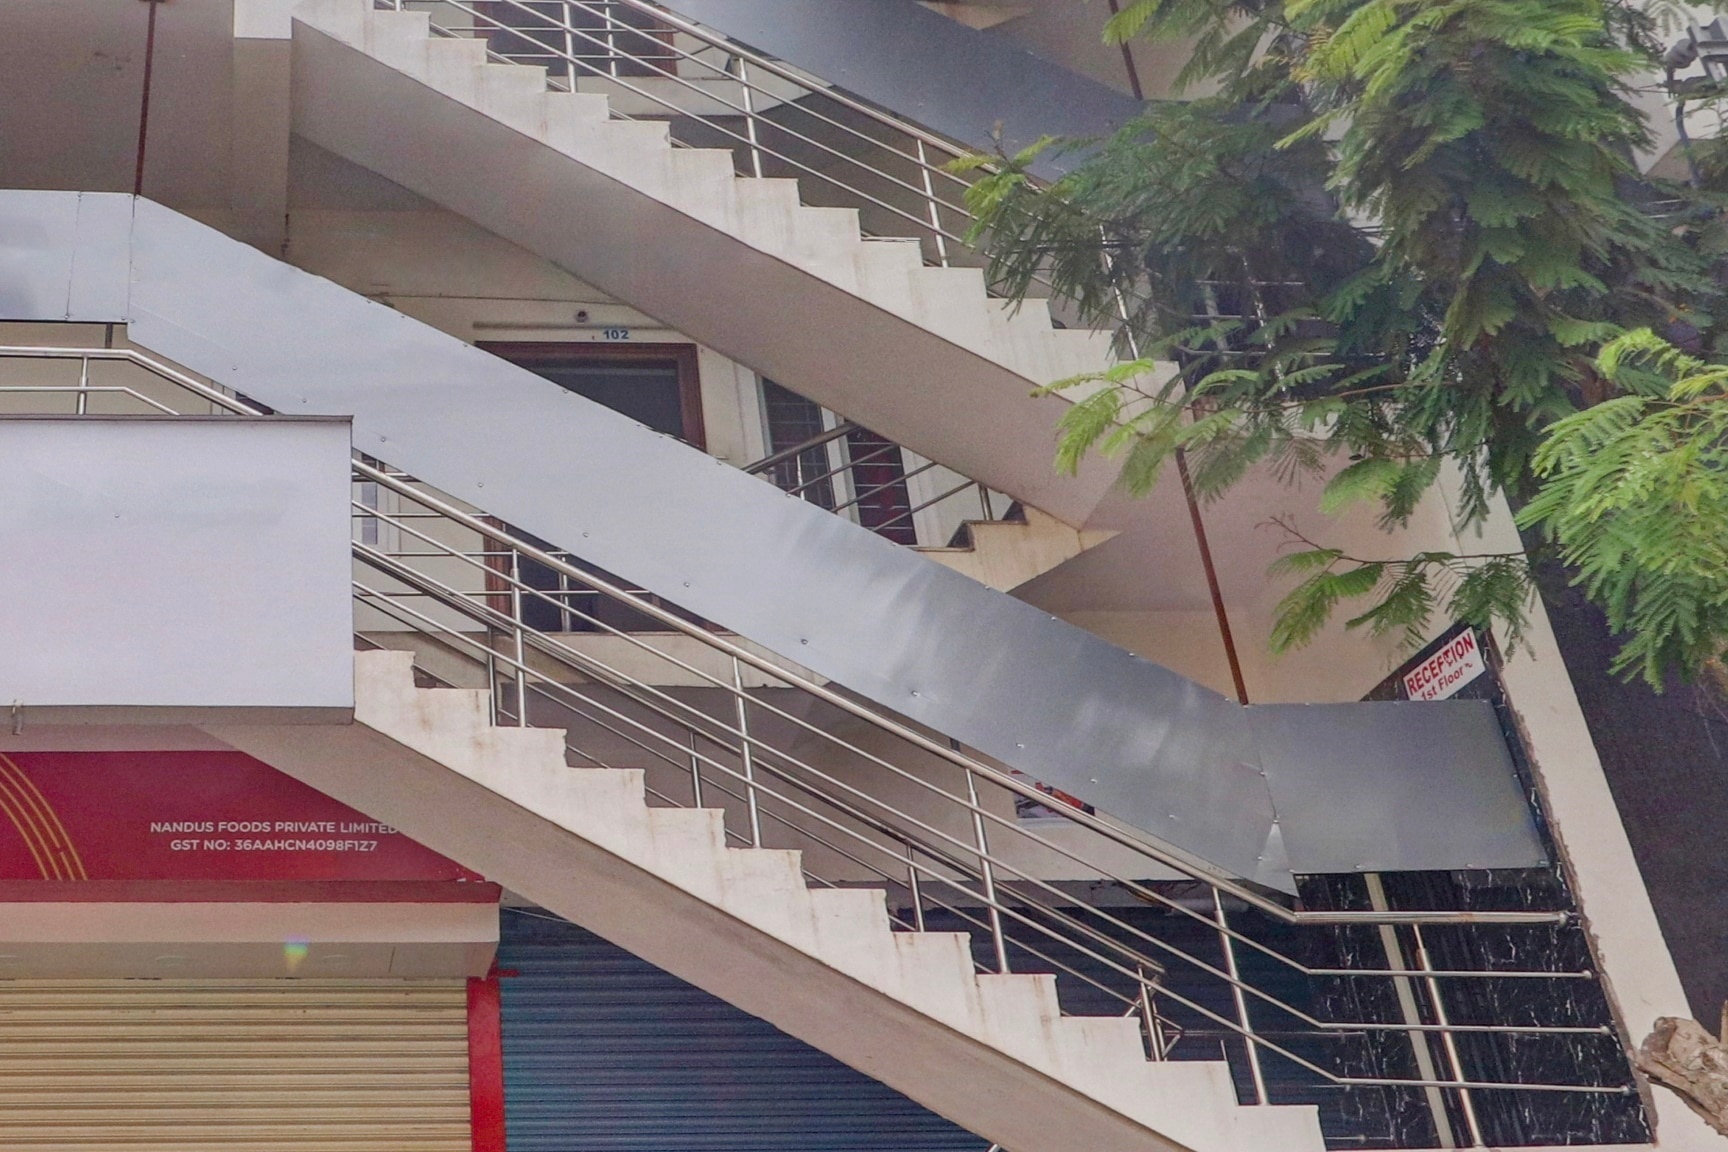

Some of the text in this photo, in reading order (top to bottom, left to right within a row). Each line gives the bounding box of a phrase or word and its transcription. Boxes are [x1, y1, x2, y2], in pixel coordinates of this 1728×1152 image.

[603, 329, 629, 340] 102
[1421, 666, 1464, 701] 1st Floor
[150, 821, 214, 833] NANDUS
[217, 821, 271, 833] FOODS
[274, 821, 336, 833] PRIVATE
[170, 839, 200, 851] GST
[203, 839, 231, 851] NO:
